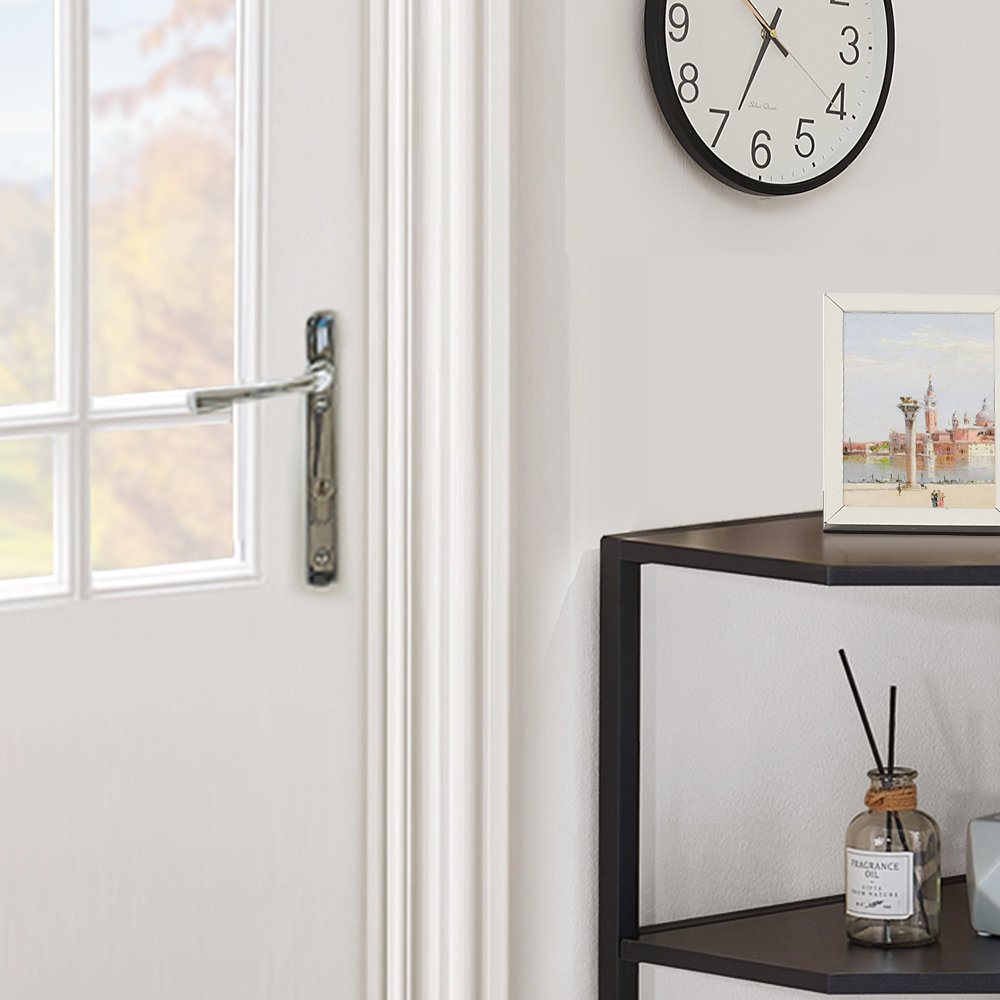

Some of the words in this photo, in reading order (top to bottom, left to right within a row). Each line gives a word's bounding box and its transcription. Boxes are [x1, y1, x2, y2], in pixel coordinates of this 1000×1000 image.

[668, 2, 690, 43] 9
[839, 25, 860, 66] 3
[677, 62, 700, 104] 8
[825, 82, 847, 121] 4
[708, 107, 731, 148] 7
[794, 117, 816, 158] 5
[750, 129, 772, 169] 6
[851, 859, 900, 871] FRAGRANCE
[864, 870, 880, 879] OIL
